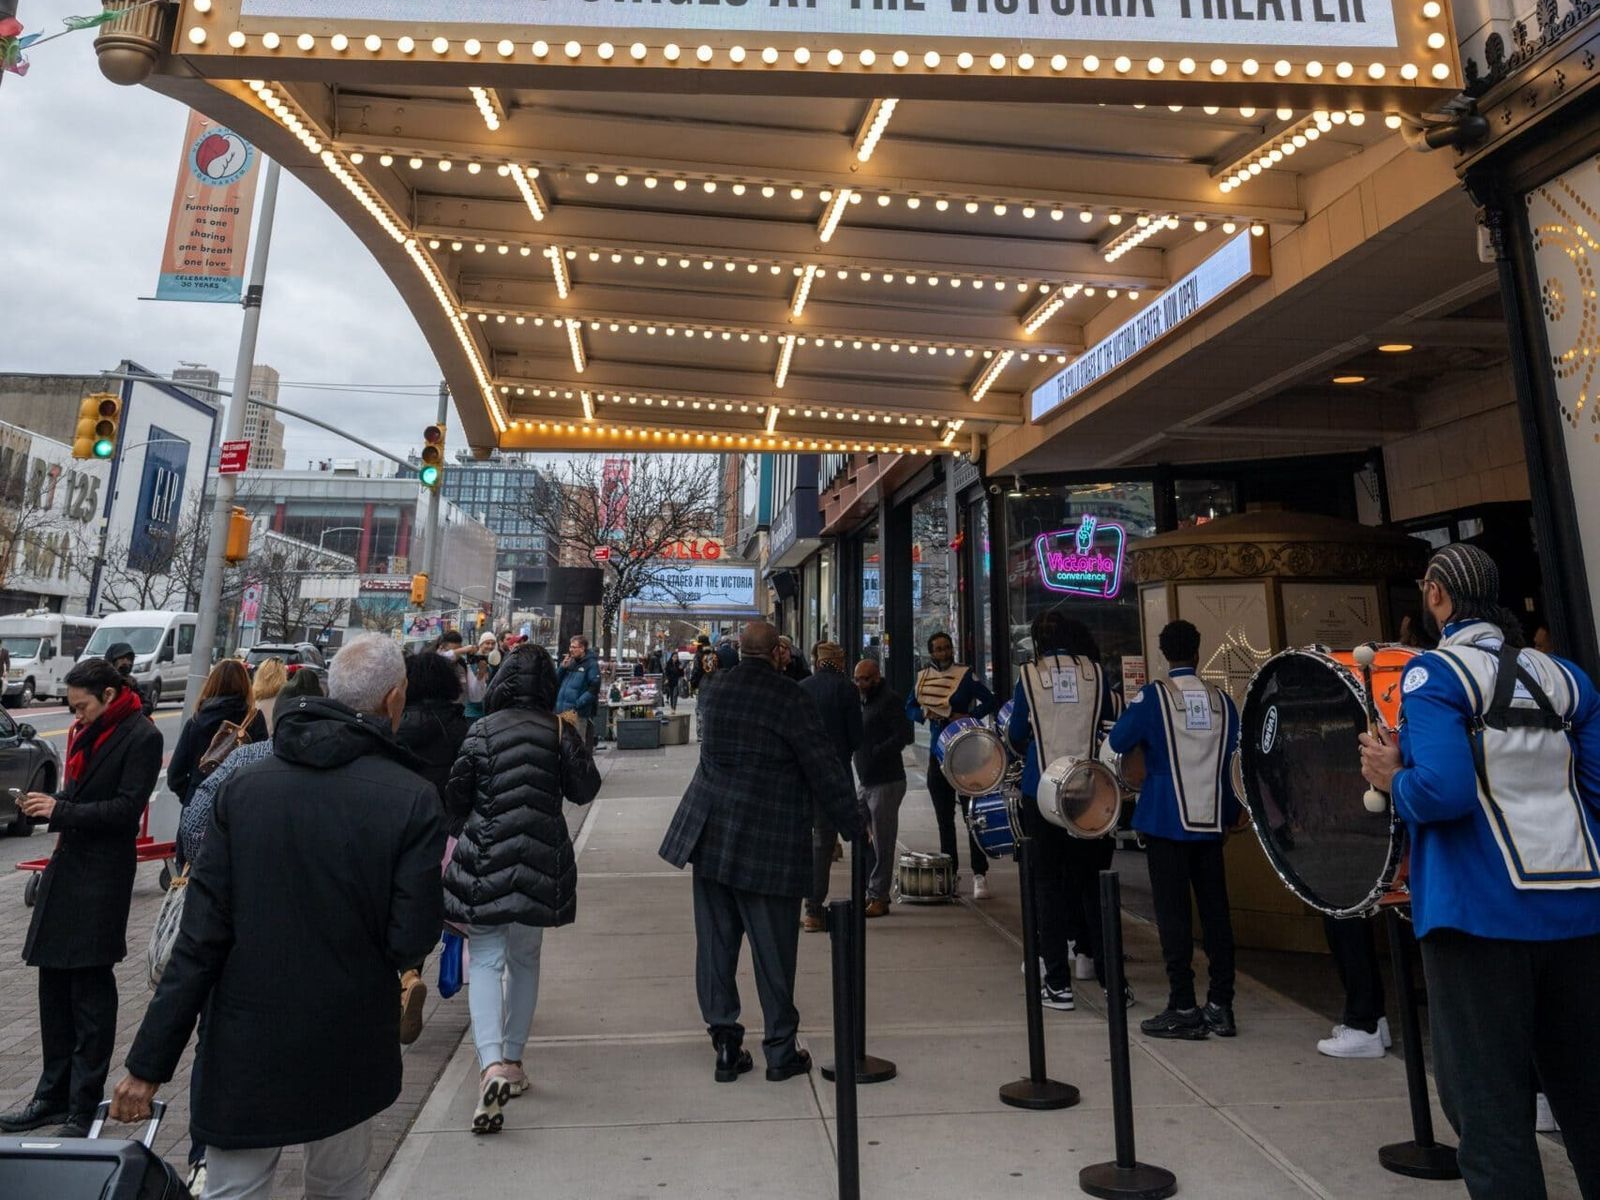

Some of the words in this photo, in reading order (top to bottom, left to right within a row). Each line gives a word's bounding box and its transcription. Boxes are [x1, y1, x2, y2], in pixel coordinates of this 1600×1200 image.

[185, 203, 240, 215] Functioning
[209, 218, 228, 227] one
[190, 230, 226, 242] sharing
[178, 244, 197, 252] one
[200, 244, 233, 254] breath
[184, 258, 202, 267] one
[205, 258, 226, 267] love
[175, 274, 228, 283] CELEBRATING
[194, 281, 220, 289] YEARS
[1113, 323, 1137, 365] VICTORIA
[1163, 292, 1178, 331] NOW
[63, 467, 101, 524] 125
[151, 466, 180, 525] GAP
[1047, 552, 1114, 572] Victoria
[1056, 570, 1107, 581] convenience
[666, 575, 693, 587] STAGES
[694, 575, 704, 587] AT
[705, 575, 719, 588] THE
[720, 575, 753, 589] VICTORIA
[1263, 710, 1276, 749] EVANS
